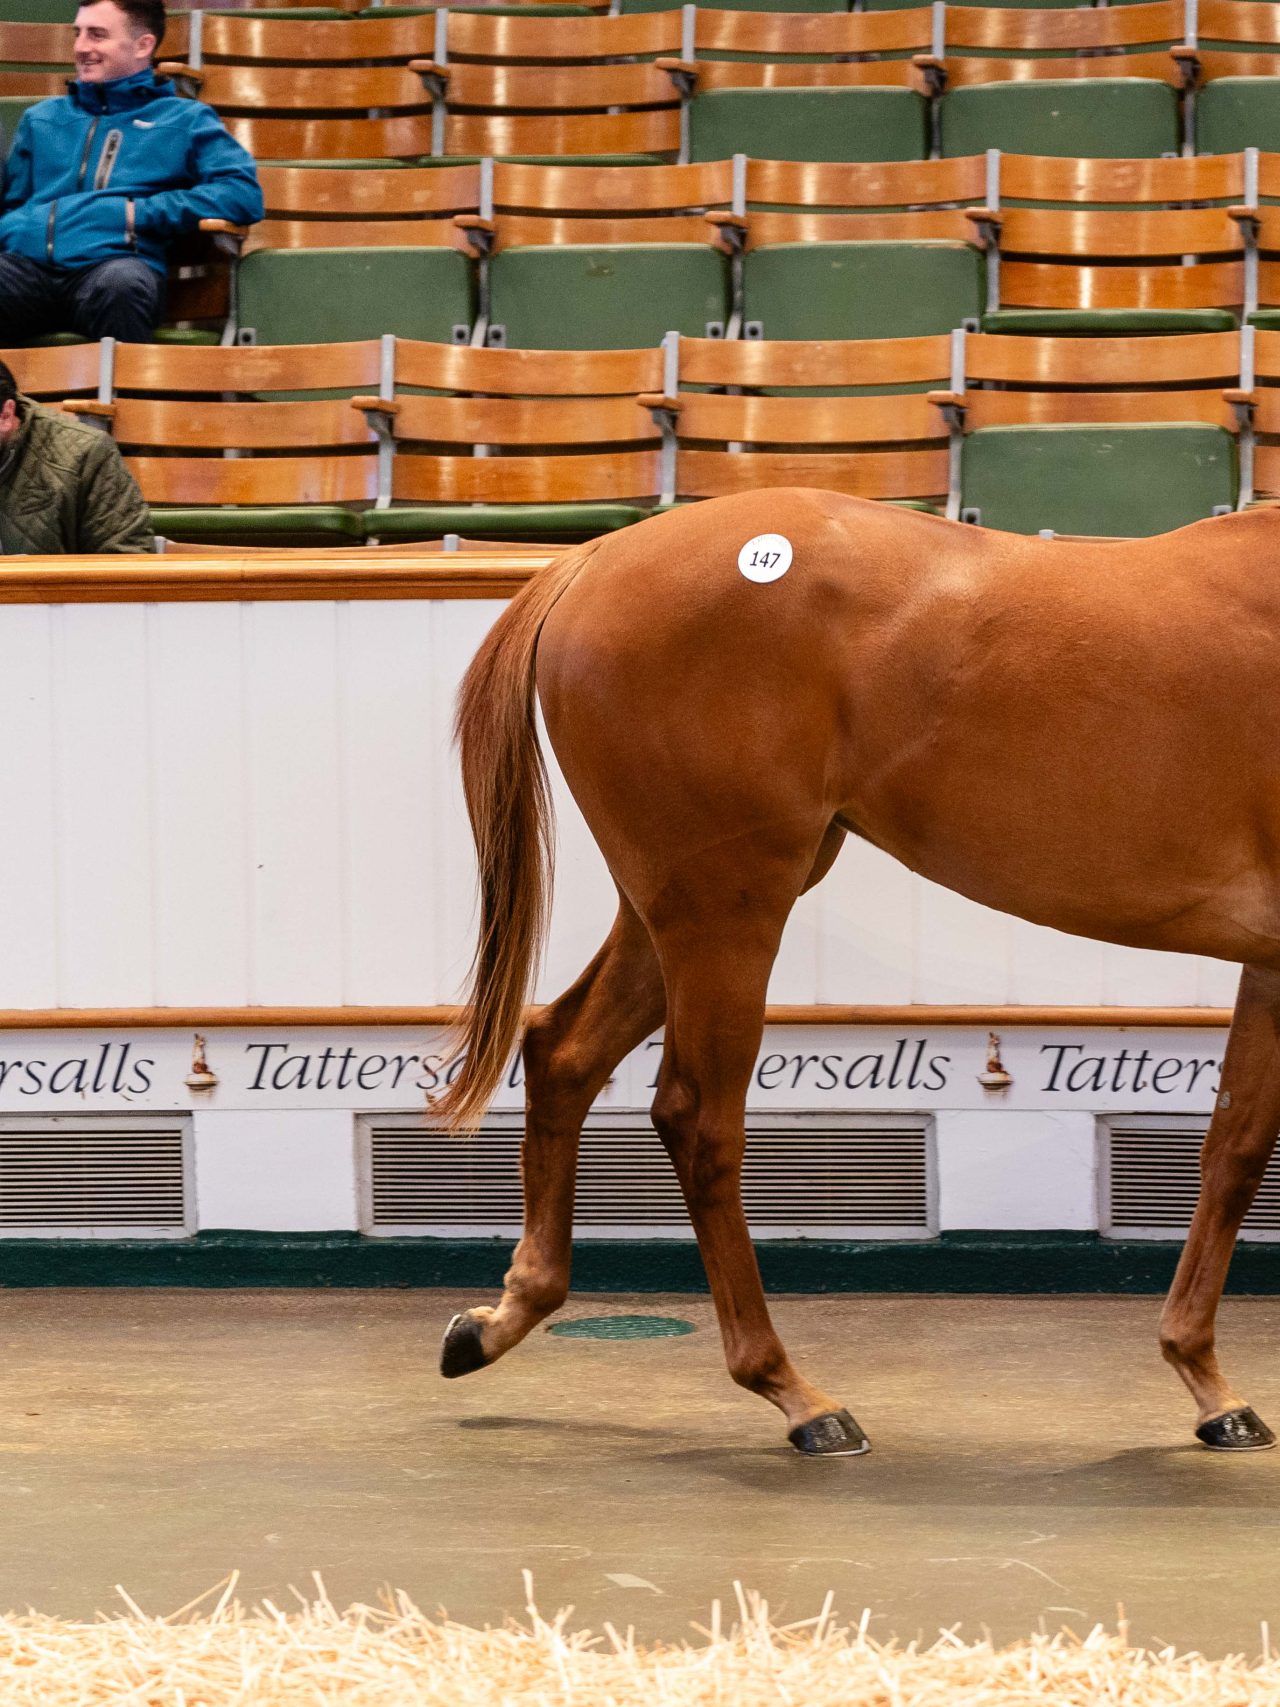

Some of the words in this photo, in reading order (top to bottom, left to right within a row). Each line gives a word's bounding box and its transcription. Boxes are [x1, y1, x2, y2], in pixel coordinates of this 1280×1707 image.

[749, 551, 781, 568] 147
[245, 1043, 524, 1089] Tattersl
[645, 1038, 951, 1091] ersalls
